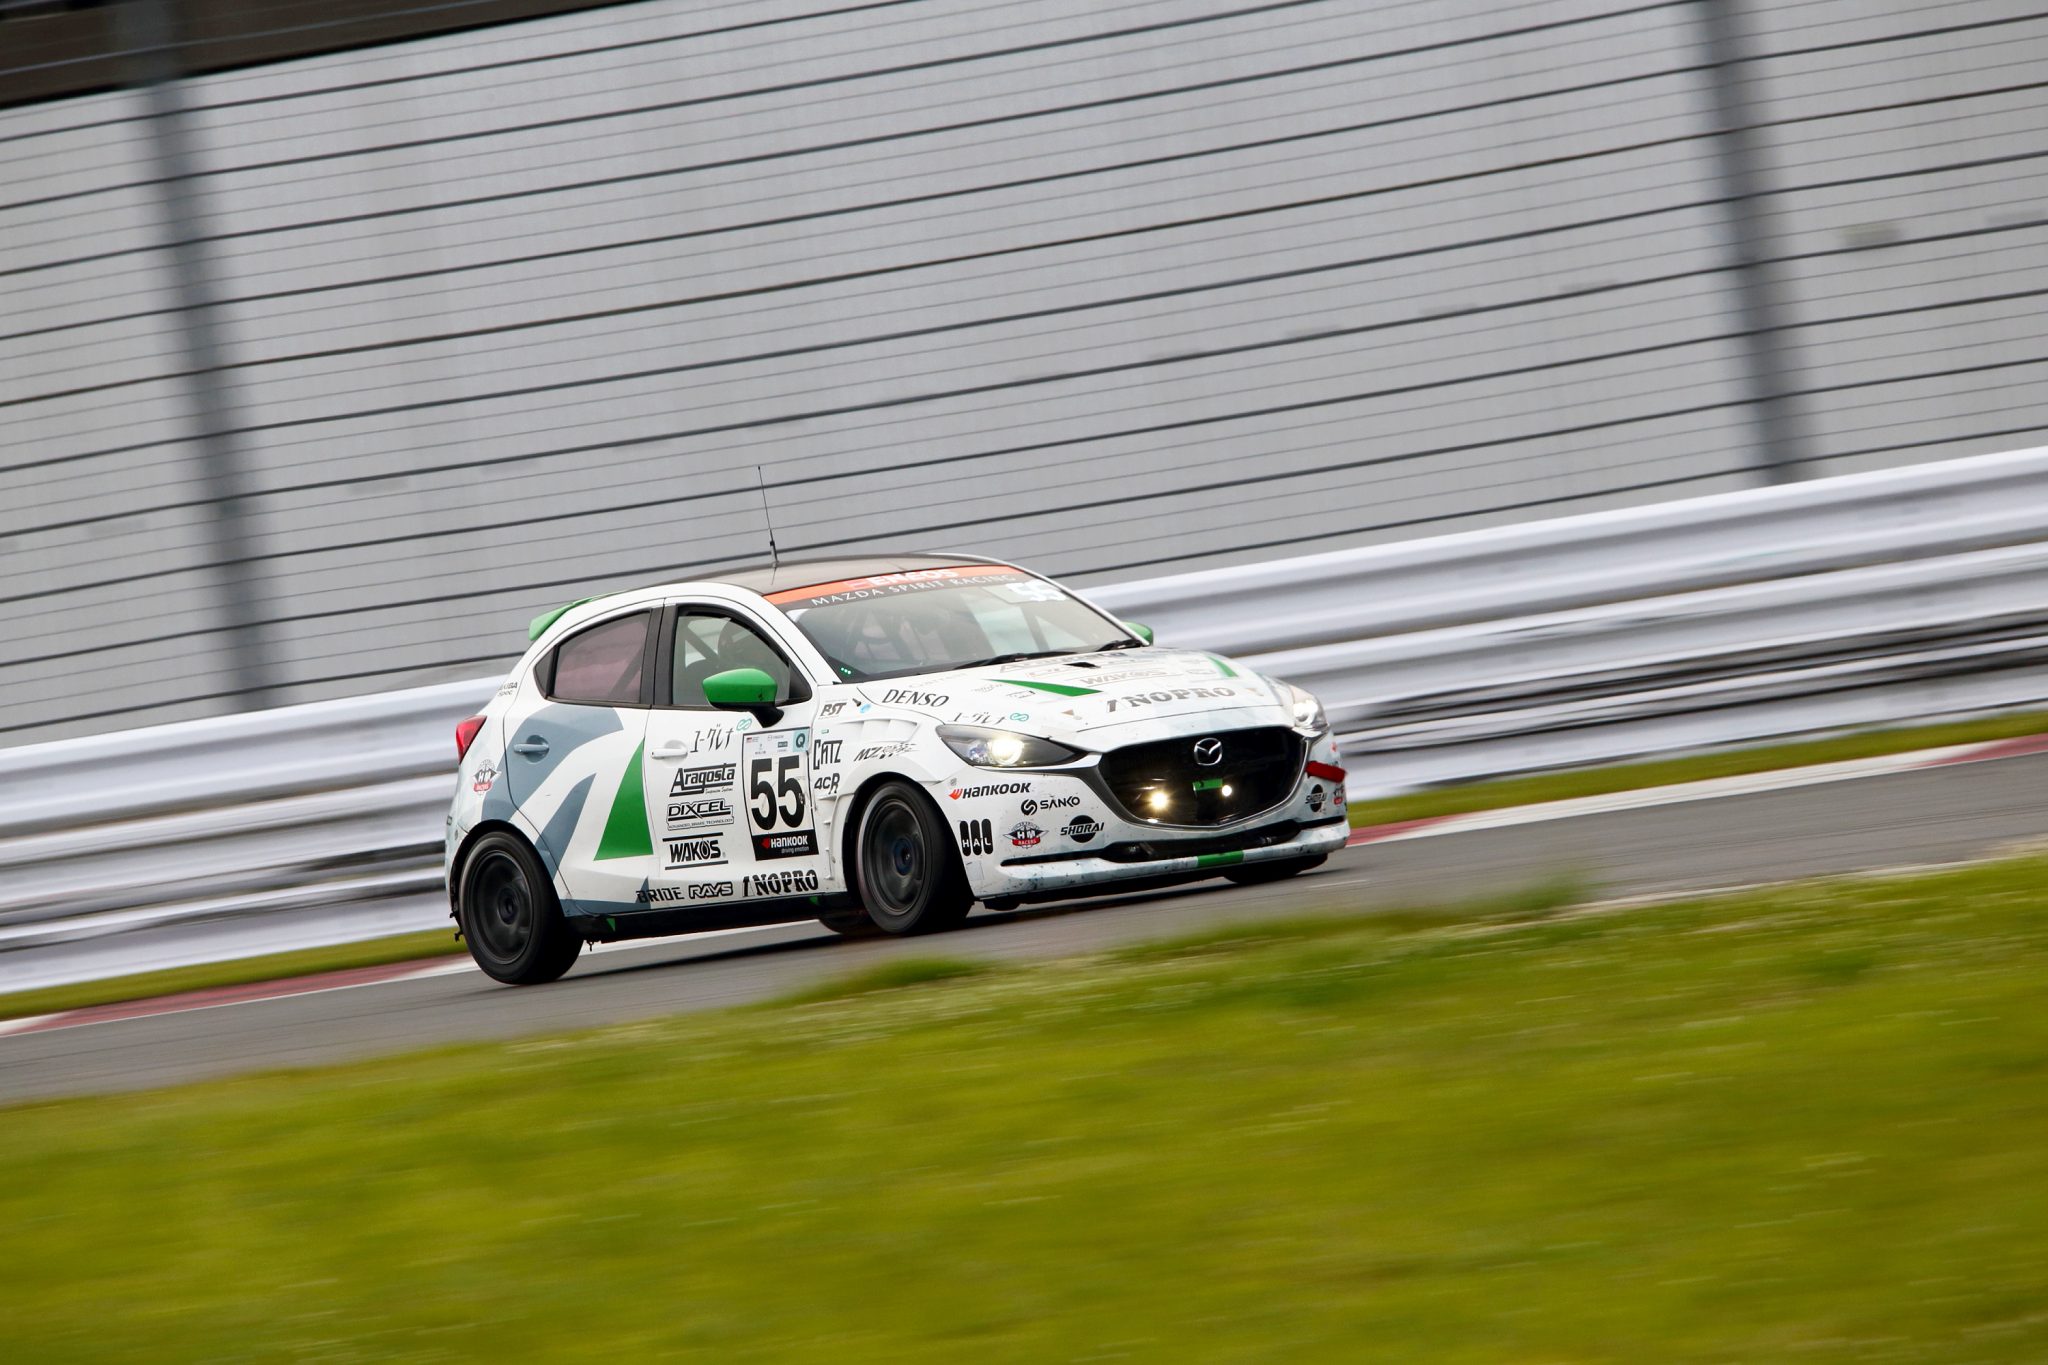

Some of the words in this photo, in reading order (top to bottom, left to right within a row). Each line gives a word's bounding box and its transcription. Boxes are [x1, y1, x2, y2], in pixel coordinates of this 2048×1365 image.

[865, 569, 959, 586] ENEOS
[810, 588, 884, 606] MAZDA
[891, 579, 943, 594] SPIRIT
[948, 574, 1017, 587] RACING
[881, 689, 950, 708] DENSO
[795, 732, 806, 749] Q
[669, 766, 736, 797] Aragosta
[750, 754, 806, 831] 55
[668, 801, 731, 818] DIXCEL
[1040, 795, 1081, 811] SANKO
[1017, 829, 1036, 840] HM
[1060, 822, 1105, 836] SHORAI
[636, 887, 686, 903] BRIDE
[688, 881, 734, 900] RAYS
